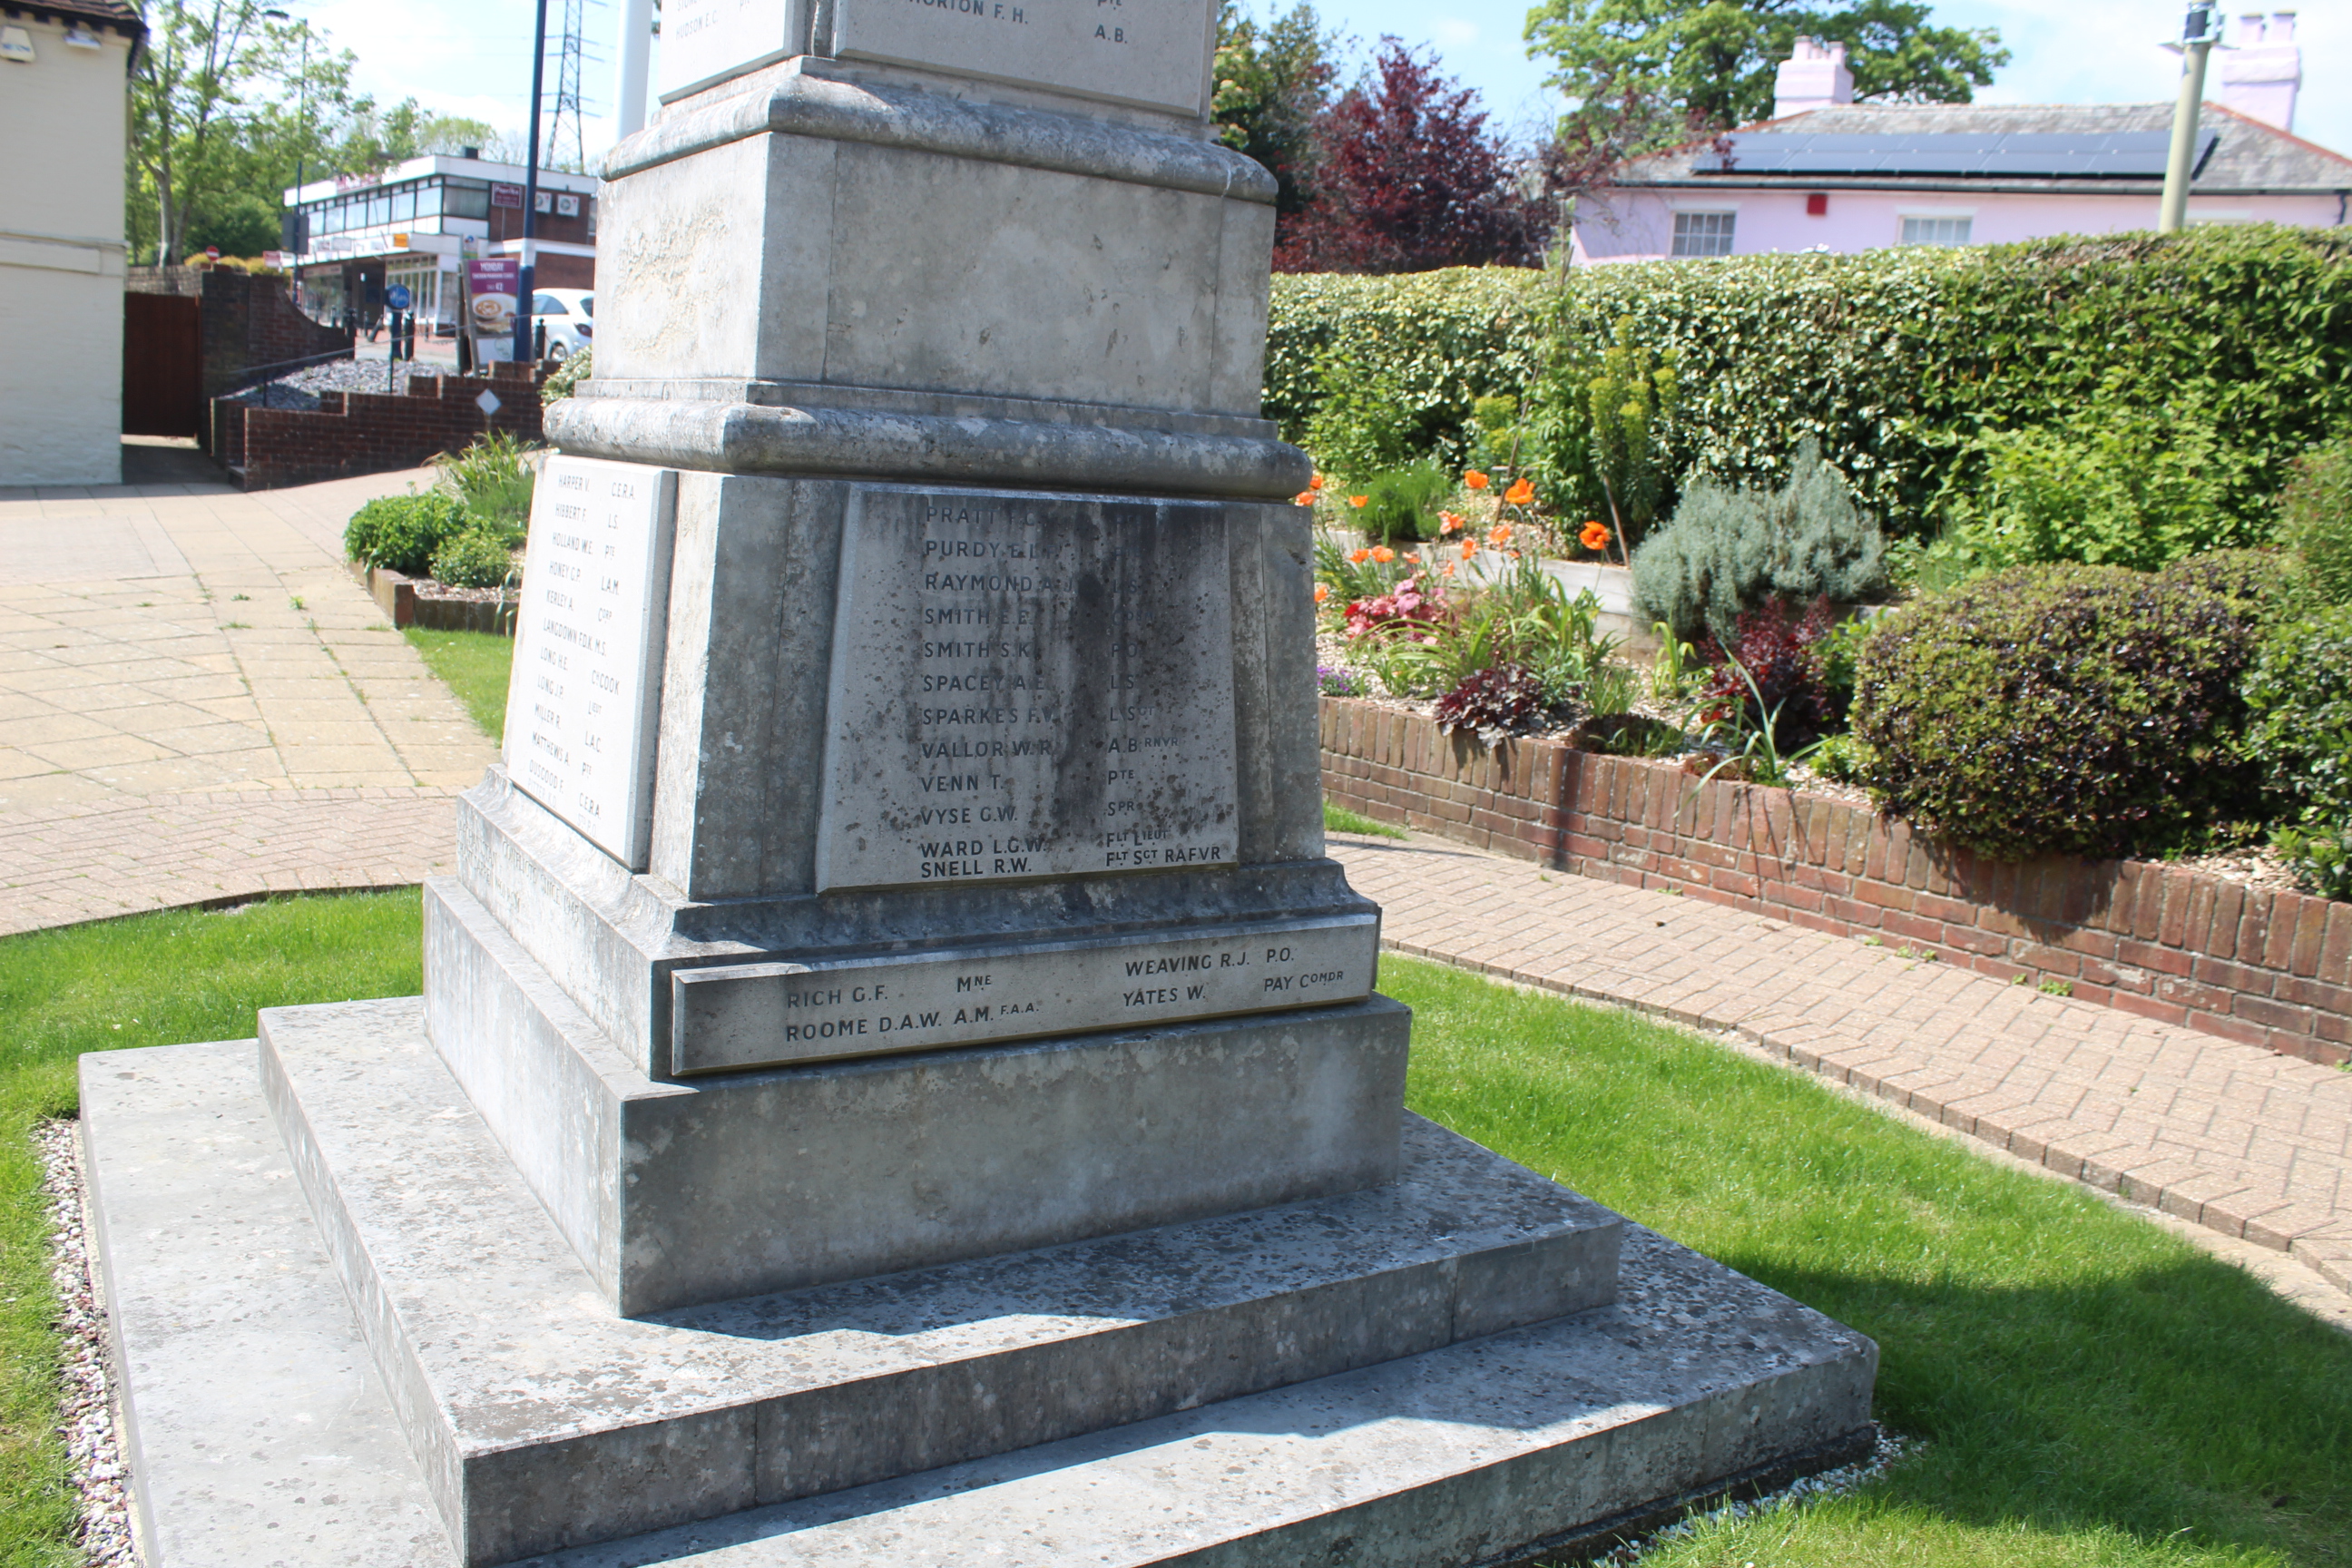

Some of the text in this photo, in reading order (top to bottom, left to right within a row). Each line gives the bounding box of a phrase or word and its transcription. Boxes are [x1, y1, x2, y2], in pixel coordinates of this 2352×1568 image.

[676, 15, 702, 41] HUDSON
[1094, 24, 1127, 44] A.B.
[559, 474, 583, 491] HARPER
[612, 482, 635, 500] C.E.R.A.
[555, 503, 580, 522] HIBBERT
[608, 513, 619, 530] L.S.
[926, 506, 998, 525] PRATT
[552, 532, 580, 552] HOLLAND
[926, 540, 1000, 559] PURDY
[549, 560, 569, 580] HONEY
[601, 575, 620, 596] L.A.M.
[925, 574, 1034, 593] RAYMOND
[546, 589, 567, 607] KERLEY
[925, 608, 990, 625] SMITH
[544, 617, 577, 645] LANGDOWN
[540, 646, 556, 666] LONG
[924, 642, 990, 658] SMITH
[537, 674, 554, 695] LONG
[599, 672, 621, 696] COOK
[923, 674, 1004, 692] SPACEY
[534, 702, 554, 723] MILLER
[922, 708, 1018, 725] SPARKES
[532, 730, 564, 762] MATTHEWS
[921, 741, 1004, 760] VALLOR
[921, 775, 979, 793] VENN
[920, 806, 1018, 826] VYSE G.W.
[920, 838, 1047, 858] WARD L.G.W.
[1164, 846, 1221, 864] RAFVR
[921, 858, 1032, 878] SNELL R.W.
[1125, 952, 1250, 977] WEAVING R.J.
[1266, 947, 1295, 963] P.O.
[1264, 976, 1293, 992] PAY
[787, 985, 888, 1009] RICH G.F.
[1122, 985, 1206, 1007] YATES W.
[786, 1012, 942, 1042] ROOME D.A.W.
